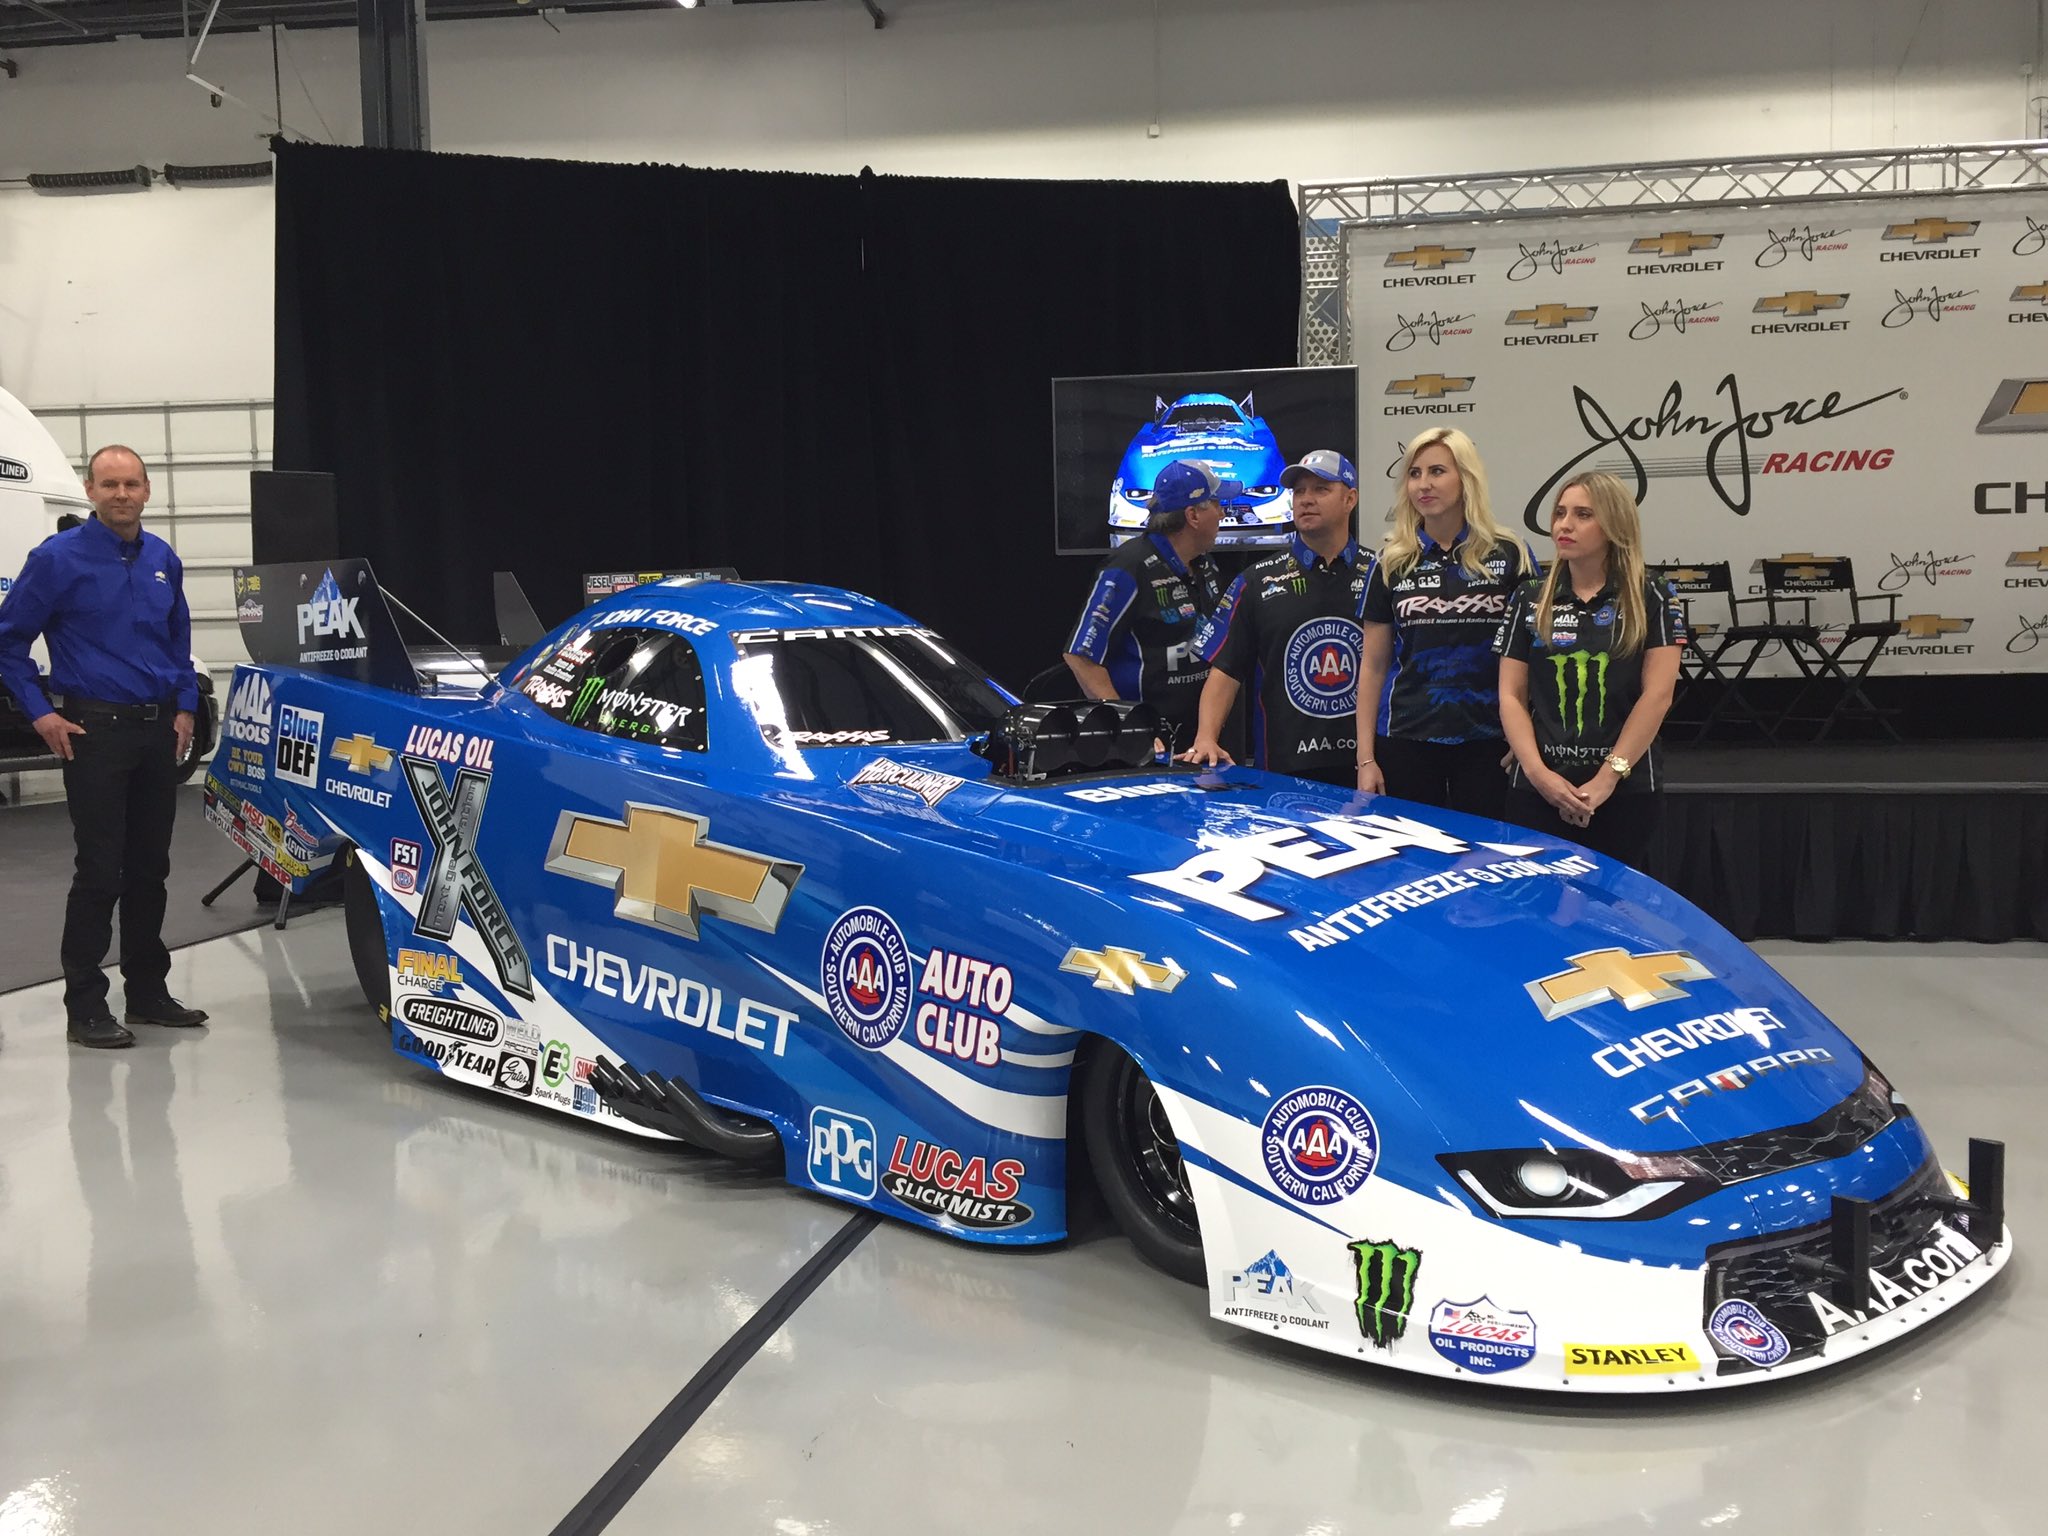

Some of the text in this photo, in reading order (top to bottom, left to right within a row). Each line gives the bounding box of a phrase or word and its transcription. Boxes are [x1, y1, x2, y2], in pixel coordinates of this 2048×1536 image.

[1815, 243, 1849, 251] RACING
[1880, 248, 1981, 262] CHEVROLET
[1564, 257, 1597, 265] RACING
[1627, 261, 1725, 275] CHEVROLET
[1383, 274, 1477, 288] CHEVROLET
[1687, 316, 1720, 324] RACING
[1943, 304, 1976, 312] RACING
[1442, 328, 1473, 336] RACING
[1504, 333, 1599, 346] CHEVROLET
[1751, 320, 1850, 335] CHEVROLET
[1384, 403, 1476, 416] CHEVROLET
[1762, 448, 1895, 474] RACING
[1255, 559, 1274, 570] AUTO
[1939, 568, 1972, 576] RACING
[587, 575, 612, 589] JESEL
[1261, 584, 1287, 599] PEAK
[1784, 579, 1834, 587] CHEVROLET
[1396, 593, 1506, 618] TRAXXAS
[297, 596, 366, 645] PEAK
[593, 608, 720, 637] JOHN FORCE
[1553, 613, 1579, 624] MAC
[300, 646, 368, 663] ANTIFREEZE COOLANT
[1290, 624, 1351, 661] AUTOMOBILE
[1167, 669, 1210, 685] ANTIFREE
[1309, 653, 1352, 677] AAA
[229, 672, 272, 726] MAC
[1288, 667, 1328, 712] SOUTHERN
[228, 719, 271, 746] TOOLS
[279, 708, 320, 745] Blue
[599, 713, 662, 736] ENERGY
[276, 736, 317, 778] DEF
[404, 724, 495, 771] LUCAS OIL
[1297, 736, 1357, 754] AAA.CO
[1543, 743, 1613, 758] MONSTE
[243, 749, 264, 766] YOUR
[227, 761, 246, 775] OWN
[247, 764, 266, 781] BOSS
[850, 757, 965, 807] HERCULINER
[325, 778, 393, 809] CHEVROLET
[1063, 782, 1190, 803] Blue
[243, 801, 265, 828] MSD
[393, 843, 418, 867] FS1
[260, 854, 292, 885] ARP
[421, 779, 524, 970] JOHN FORCE
[1286, 868, 1477, 952] ANTIFREEZE
[830, 914, 906, 975] AUTOMOBILE CLUB
[397, 948, 464, 984] FINAL
[846, 956, 885, 994] AAA
[397, 974, 443, 992] CHARGE
[919, 947, 1014, 1014] AUTO
[546, 933, 800, 1057] CHEVROLET
[826, 963, 908, 1043] SOUTHERN CALIFORNIA
[407, 1001, 496, 1038] FREIGHTLINER
[915, 1001, 1002, 1068] CLUB
[503, 1040, 539, 1057] RACING
[535, 1086, 572, 1107] Spark Plugs
[1271, 1091, 1371, 1140] AUTOMOBILE CLUB
[812, 1118, 873, 1183] PPG
[1292, 1128, 1343, 1158] AAA
[888, 1134, 1025, 1201] LUCAS
[1266, 1135, 1374, 1201] SOUTHERN CALIFORNIA
[1222, 1269, 1327, 1315] PEAK
[1224, 1306, 1330, 1330] ANTIFREEZE COOLANT
[1713, 1304, 1748, 1332] AUTOMOBILE
[1440, 1320, 1528, 1342] LUCAS
[1731, 1326, 1764, 1341] AAA
[1435, 1337, 1530, 1358] OIL PRODUCTS
[1572, 1347, 1687, 1366] STANLEY
[1469, 1355, 1496, 1368] INC.
